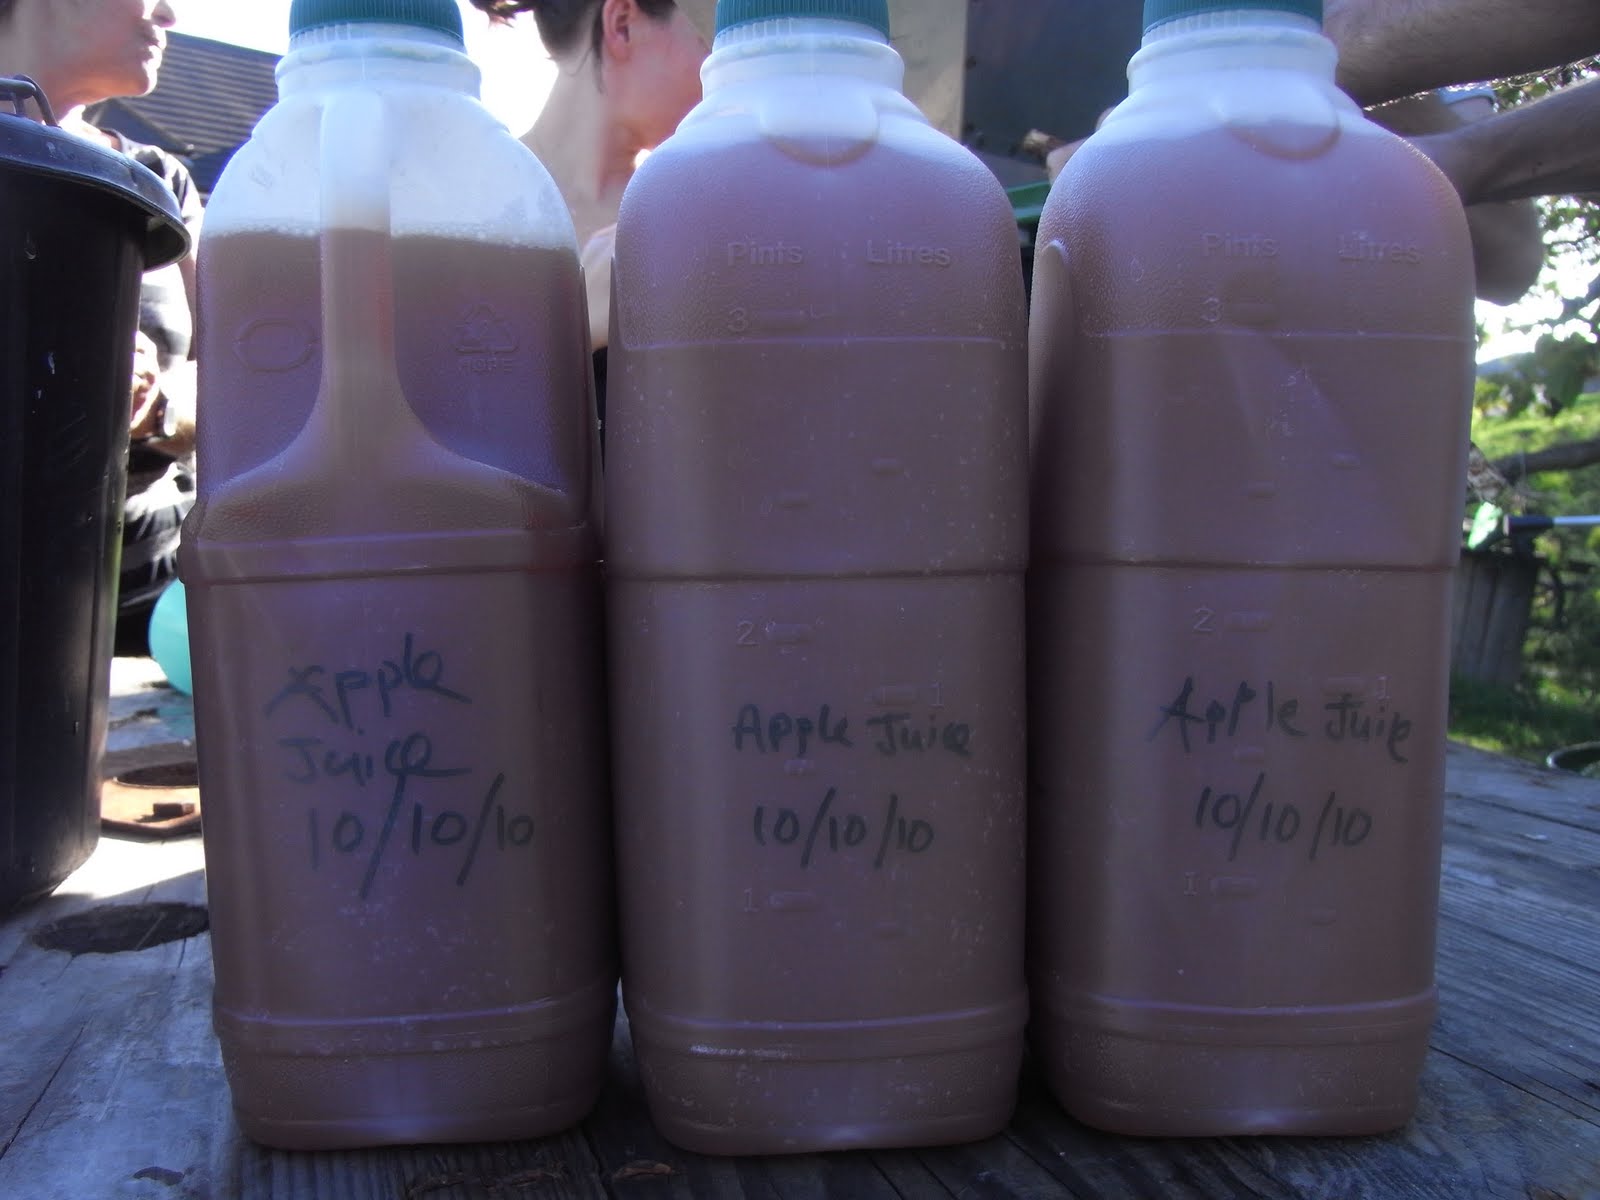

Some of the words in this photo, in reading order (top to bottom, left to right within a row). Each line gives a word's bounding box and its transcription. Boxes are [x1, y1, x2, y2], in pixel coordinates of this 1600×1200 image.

[727, 241, 803, 267] Pints
[866, 240, 952, 269] Litres
[1200, 232, 1279, 258] Pints
[1338, 231, 1421, 265] Litres
[727, 307, 749, 333] 3
[1201, 297, 1223, 323] 3
[735, 619, 760, 648] 2
[1192, 606, 1216, 634] 2
[263, 632, 473, 730] Apple
[731, 704, 855, 758] Apple
[1145, 677, 1307, 756] Apple
[752, 786, 935, 871] 10/10/10
[1195, 771, 1374, 863] 10/10/10
[308, 772, 535, 900] 10/10/10
[743, 888, 760, 913] 1
